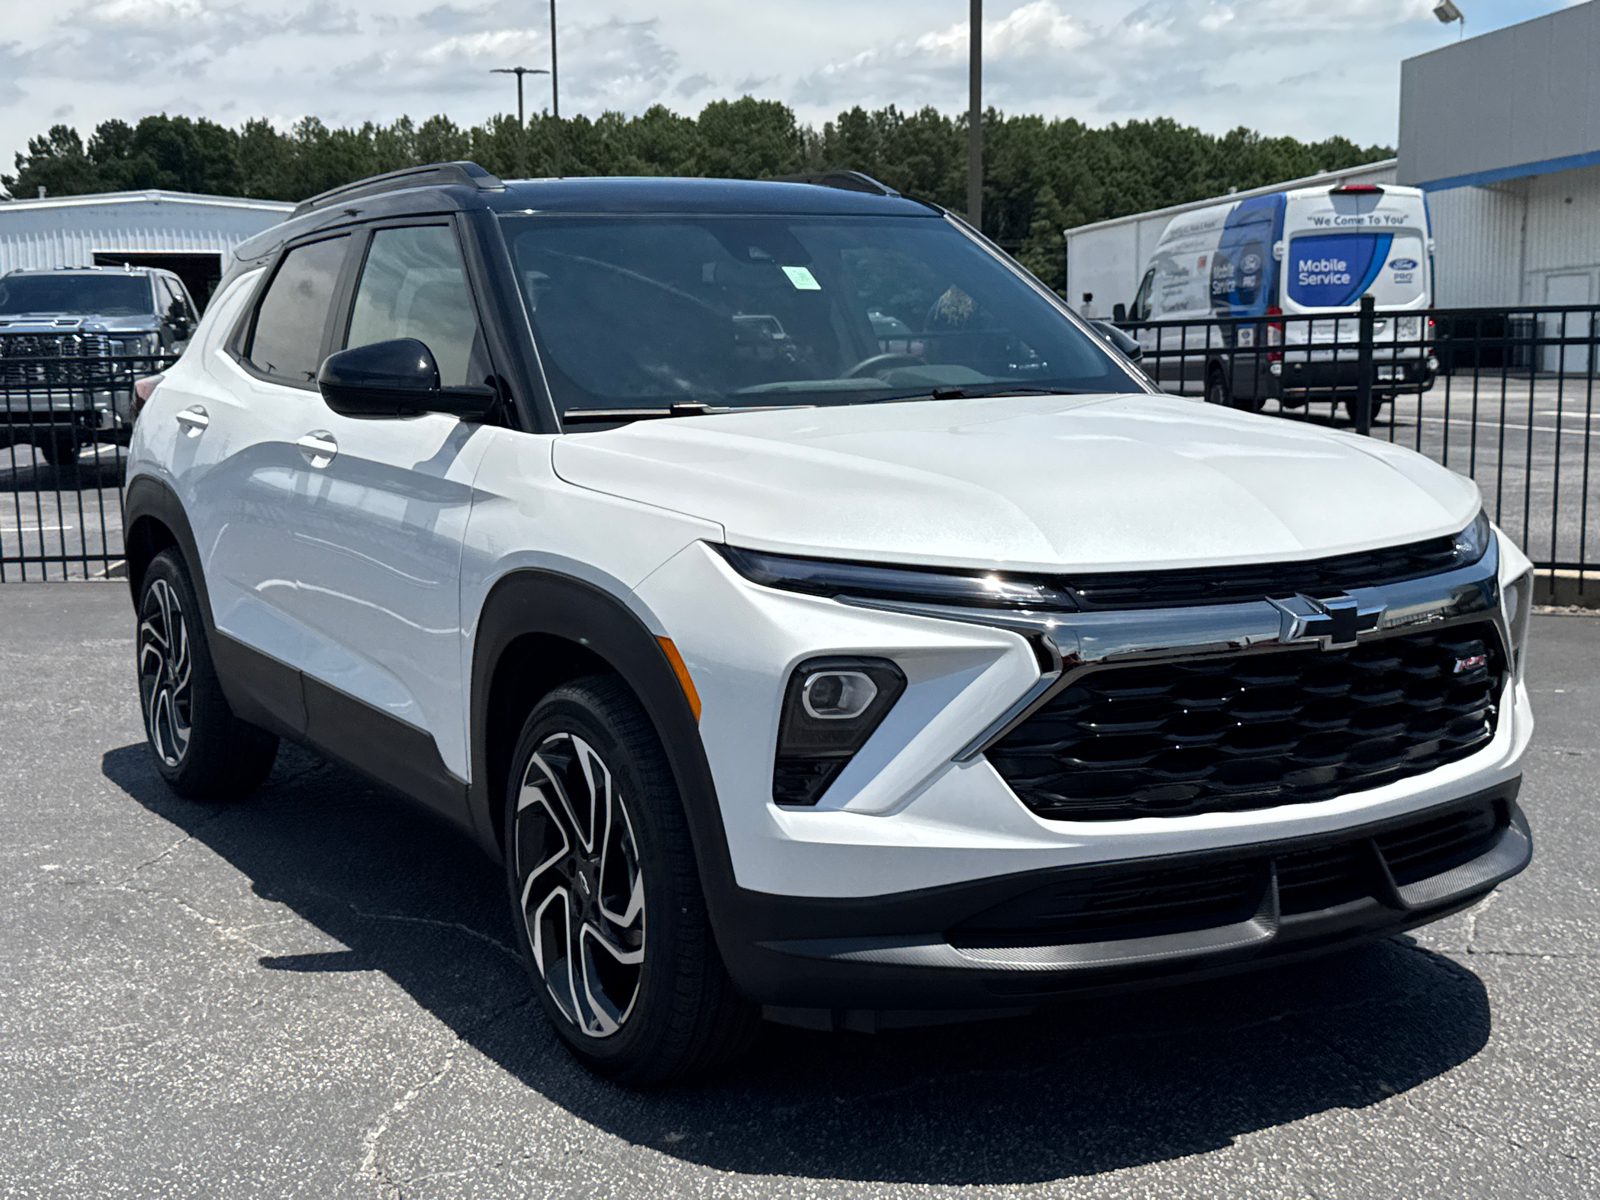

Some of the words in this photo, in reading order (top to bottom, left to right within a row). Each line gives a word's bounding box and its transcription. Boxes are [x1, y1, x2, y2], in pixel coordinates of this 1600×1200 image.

[1334, 215, 1365, 226] Come
[1368, 215, 1381, 225] To
[1213, 262, 1235, 279] Mobile
[1298, 258, 1347, 273] Mobile
[1391, 259, 1416, 270] Ford
[1243, 275, 1257, 288] PRO
[1298, 272, 1351, 285] Service
[1394, 273, 1412, 281] PRO
[1212, 279, 1236, 295] Service
